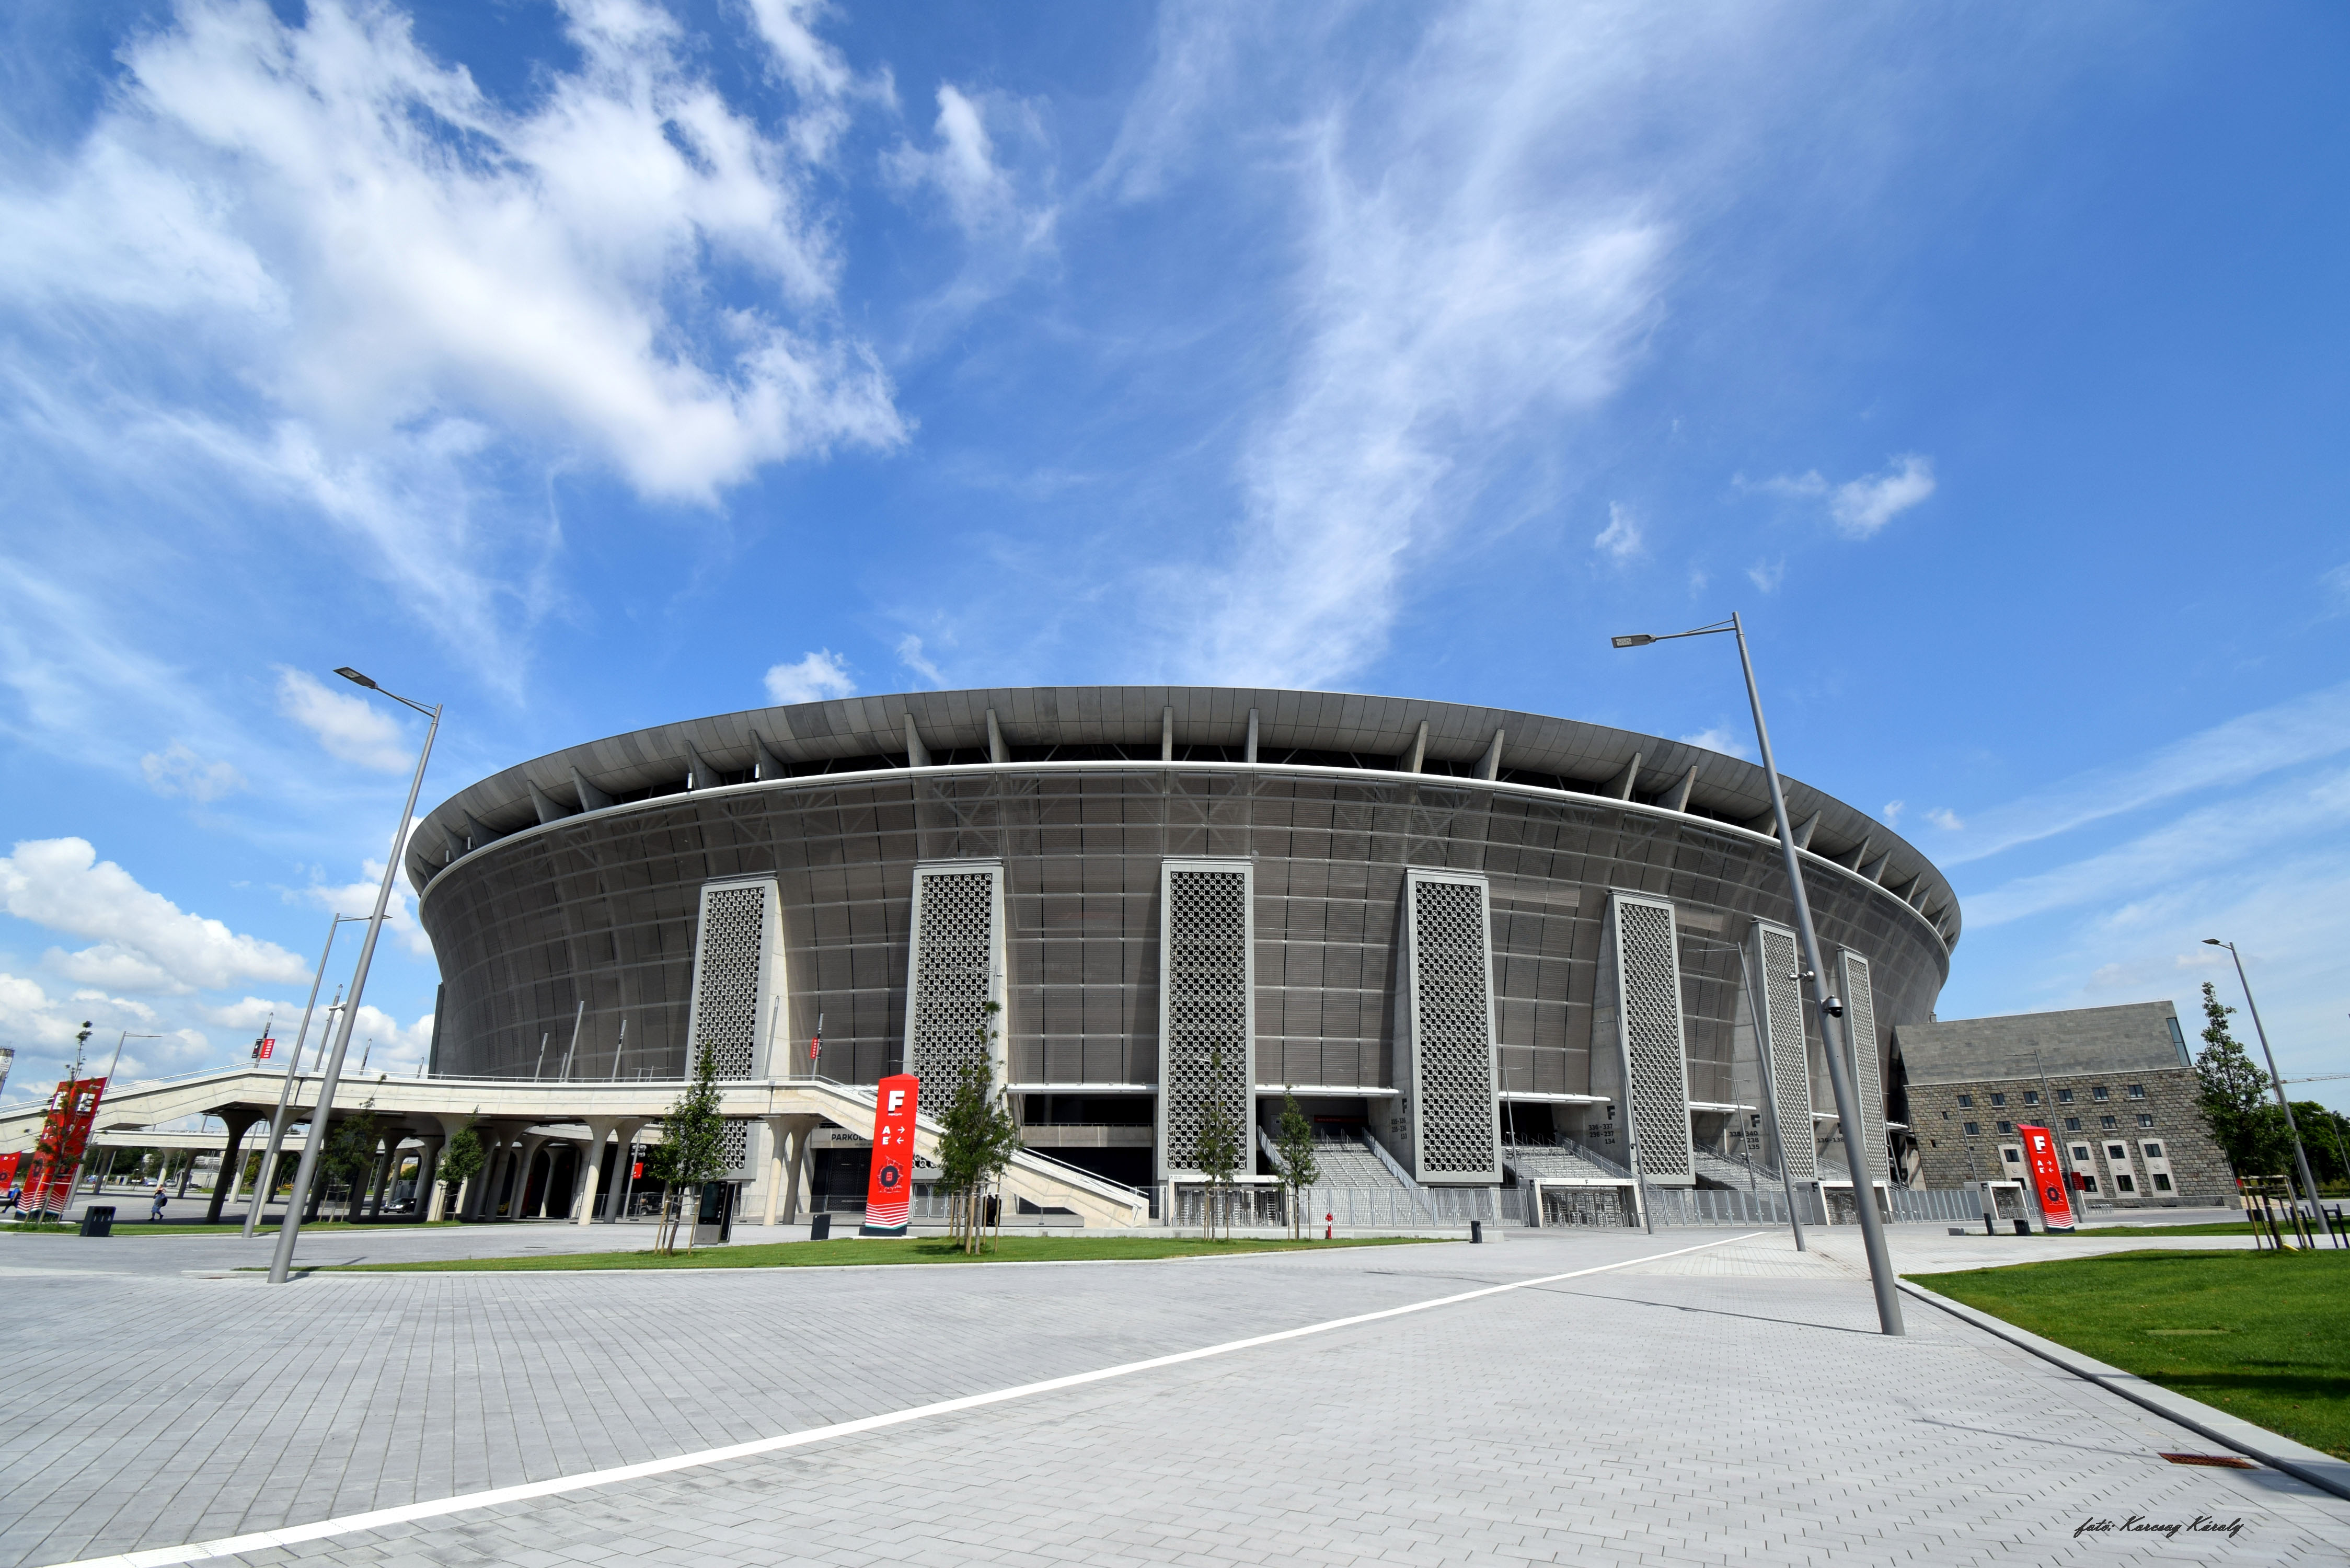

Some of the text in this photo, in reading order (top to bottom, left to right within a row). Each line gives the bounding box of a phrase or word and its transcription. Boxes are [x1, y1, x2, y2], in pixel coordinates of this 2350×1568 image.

[77, 1093, 96, 1112] E
[888, 1090, 905, 1112] F
[1402, 1098, 1407, 1114] F
[1607, 1105, 1615, 1120] F
[1750, 1114, 1760, 1127] F
[882, 1126, 891, 1134] A
[2033, 1136, 2046, 1150] F
[1811, 1182, 1818, 1192] F
